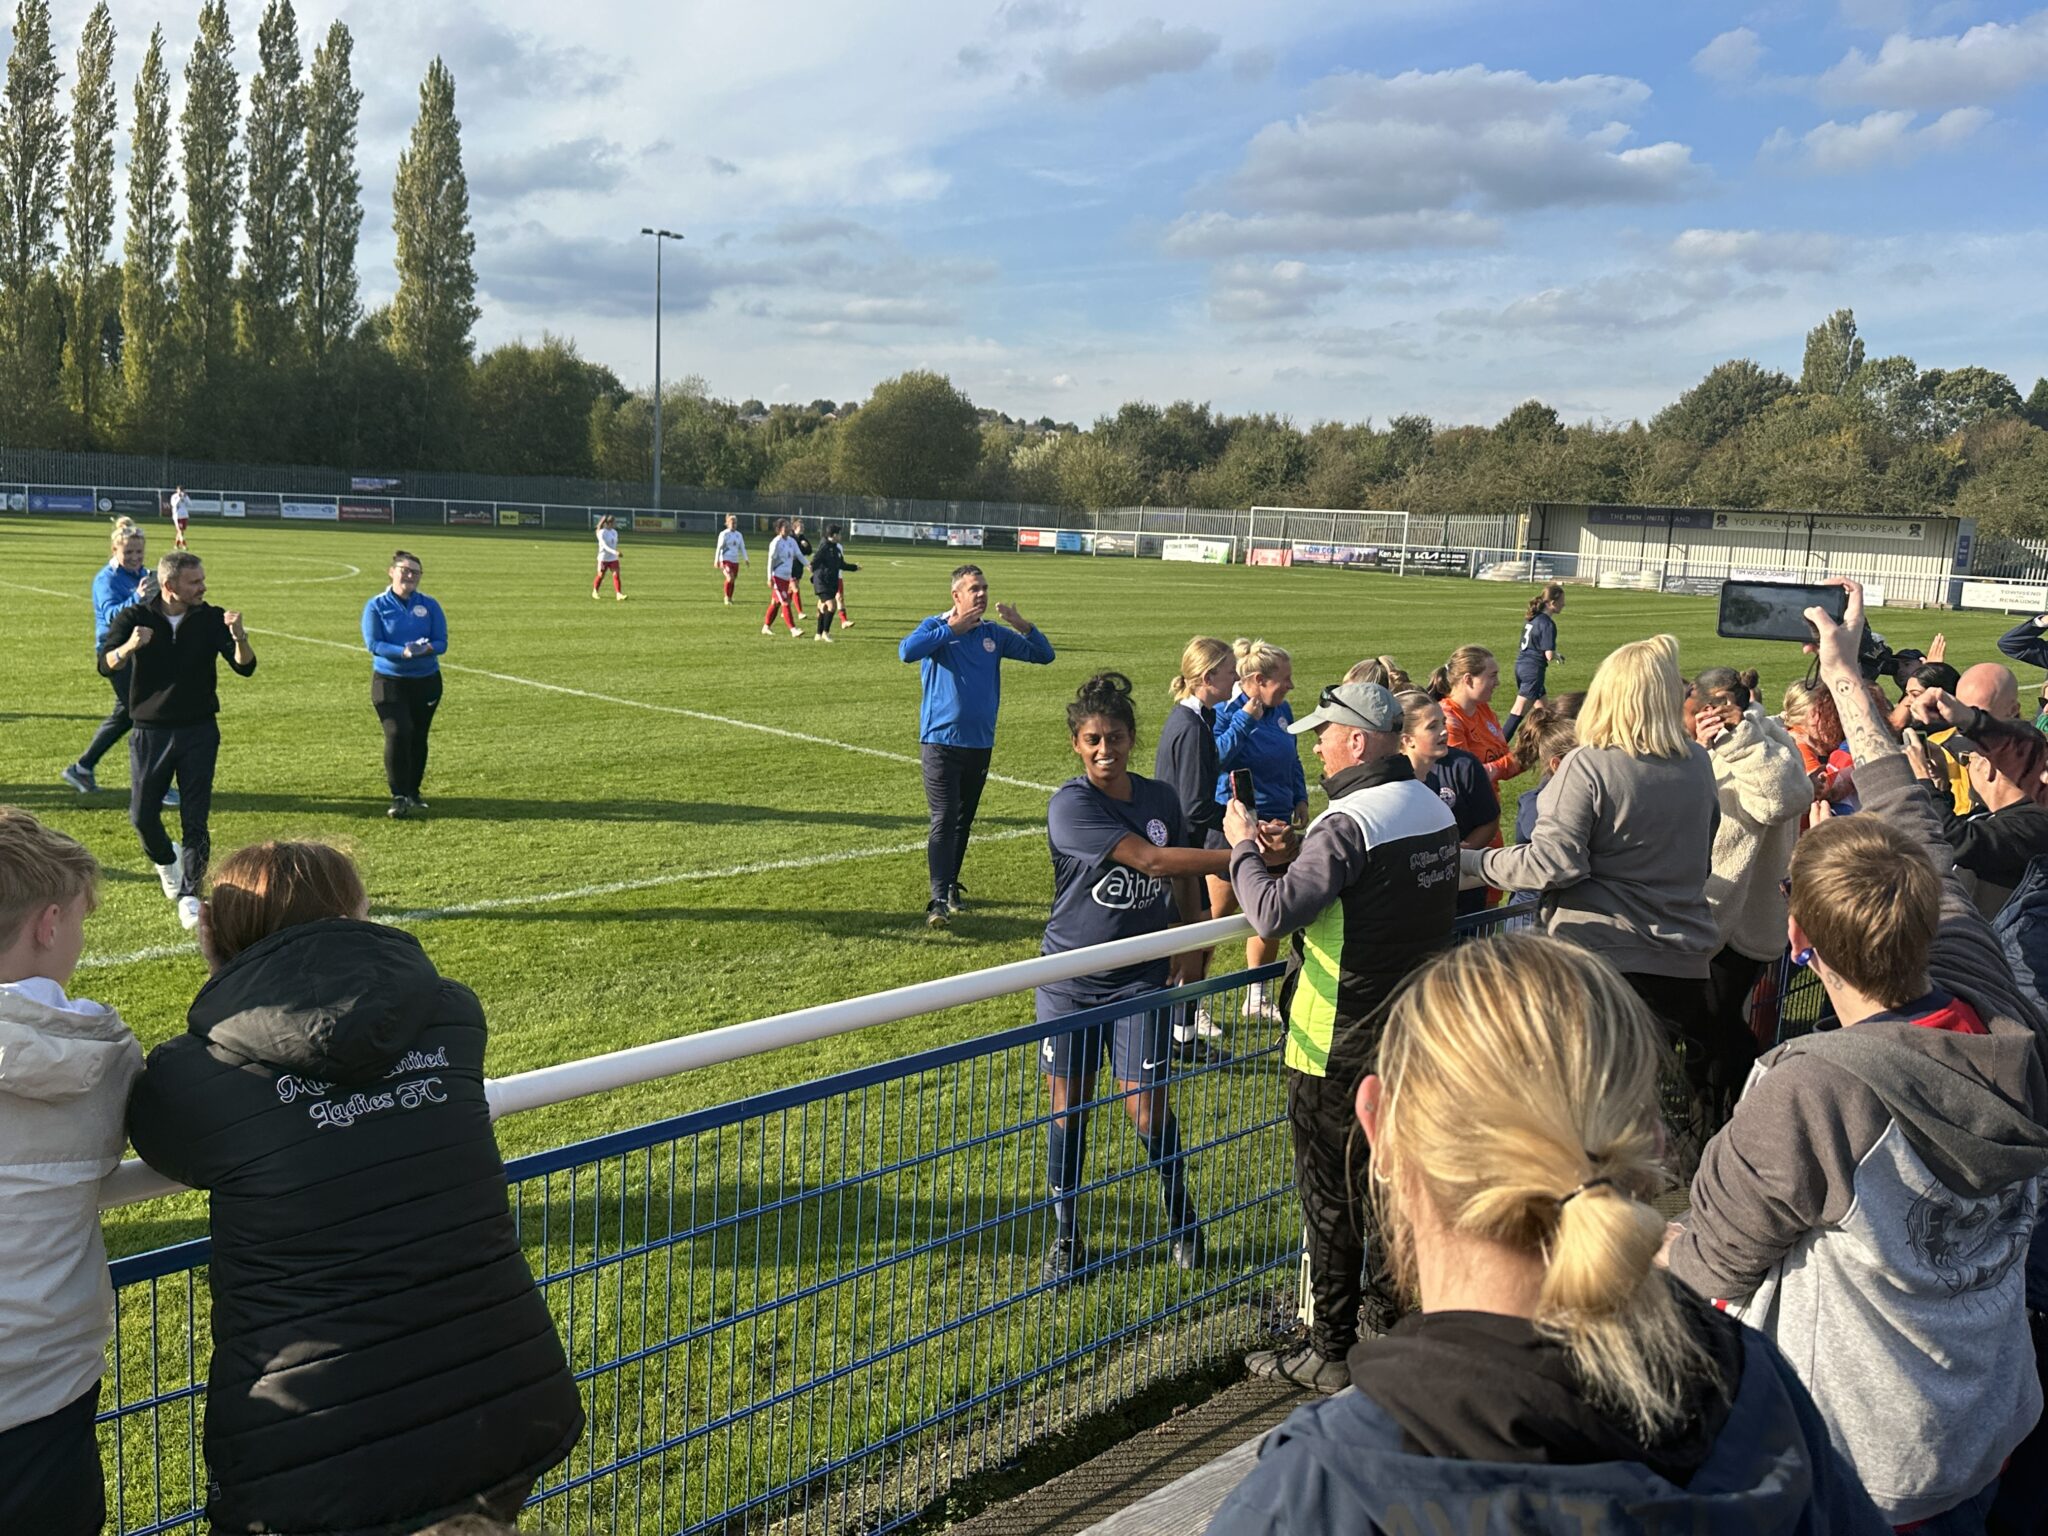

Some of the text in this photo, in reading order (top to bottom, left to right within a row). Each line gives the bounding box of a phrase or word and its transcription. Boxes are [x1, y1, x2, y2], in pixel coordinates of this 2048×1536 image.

[1734, 518, 1756, 527] YOU
[1759, 518, 1779, 528] ARE
[1781, 519, 1802, 529] NOT
[1834, 521, 1842, 531] IF
[1844, 522, 1868, 533] YOU
[1870, 524, 1902, 534] SPEAK
[1378, 549, 1392, 558] Ken
[382, 1046, 450, 1079] nited
[309, 1076, 448, 1129] Ladies FC
